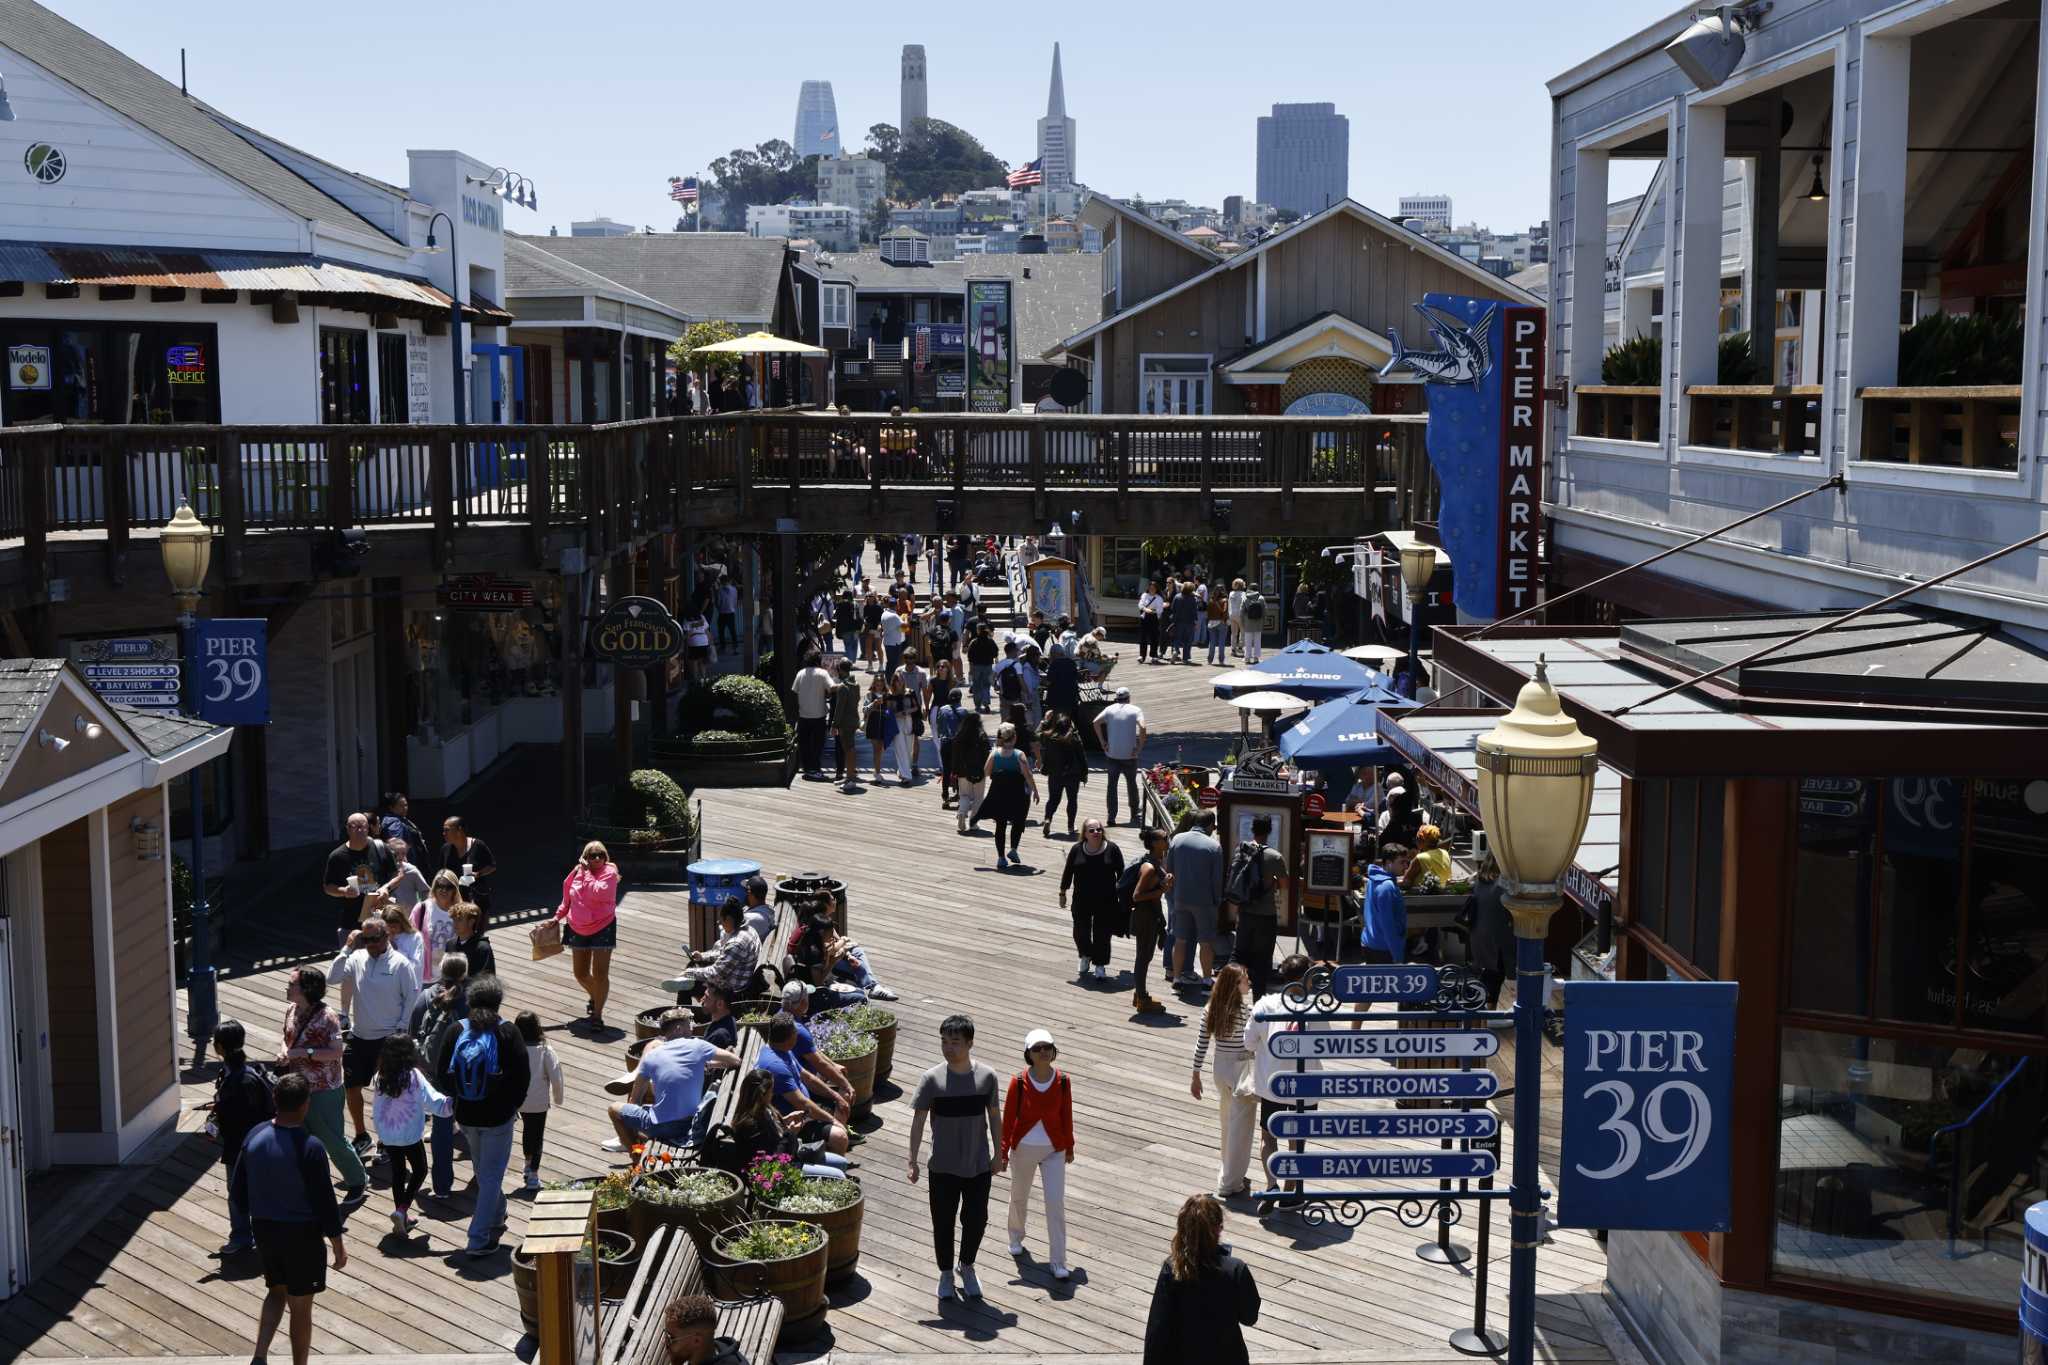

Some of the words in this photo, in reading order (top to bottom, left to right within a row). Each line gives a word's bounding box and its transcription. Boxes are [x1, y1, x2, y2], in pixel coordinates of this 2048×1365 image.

[9, 351, 46, 364] Modelo
[1513, 320, 1536, 427] PIER
[1508, 445, 1533, 608] MARKET
[449, 592, 477, 601] CITY
[481, 592, 514, 601] WEAR
[114, 643, 137, 653] PIER
[137, 643, 149, 653] 39
[205, 637, 258, 656] PIER
[600, 631, 671, 651] GOLD
[97, 667, 122, 676] LEVEL
[123, 667, 129, 676] 2
[129, 667, 158, 676] SHOPS
[205, 658, 262, 702] 39
[106, 681, 123, 689] BAY
[124, 681, 153, 689] VIEWS
[126, 695, 160, 704] CANTINA
[1235, 779, 1253, 788] PIER
[1254, 780, 1285, 790] MARKET
[1346, 975, 1399, 994] PIER
[1401, 974, 1428, 993] 39
[1313, 1038, 1378, 1054] SWISS
[1384, 1037, 1447, 1053] LOUIS
[1584, 1030, 1709, 1073] PIER
[1321, 1077, 1450, 1094] RESTROOMS
[1309, 1119, 1372, 1135] LEVEL
[1378, 1119, 1390, 1135] 2
[1396, 1118, 1466, 1134] SHOPS
[1576, 1080, 1713, 1181] 39
[1475, 1141, 1497, 1149] Enter
[1322, 1159, 1361, 1175] BAY
[1367, 1158, 1433, 1174] VIEWS
